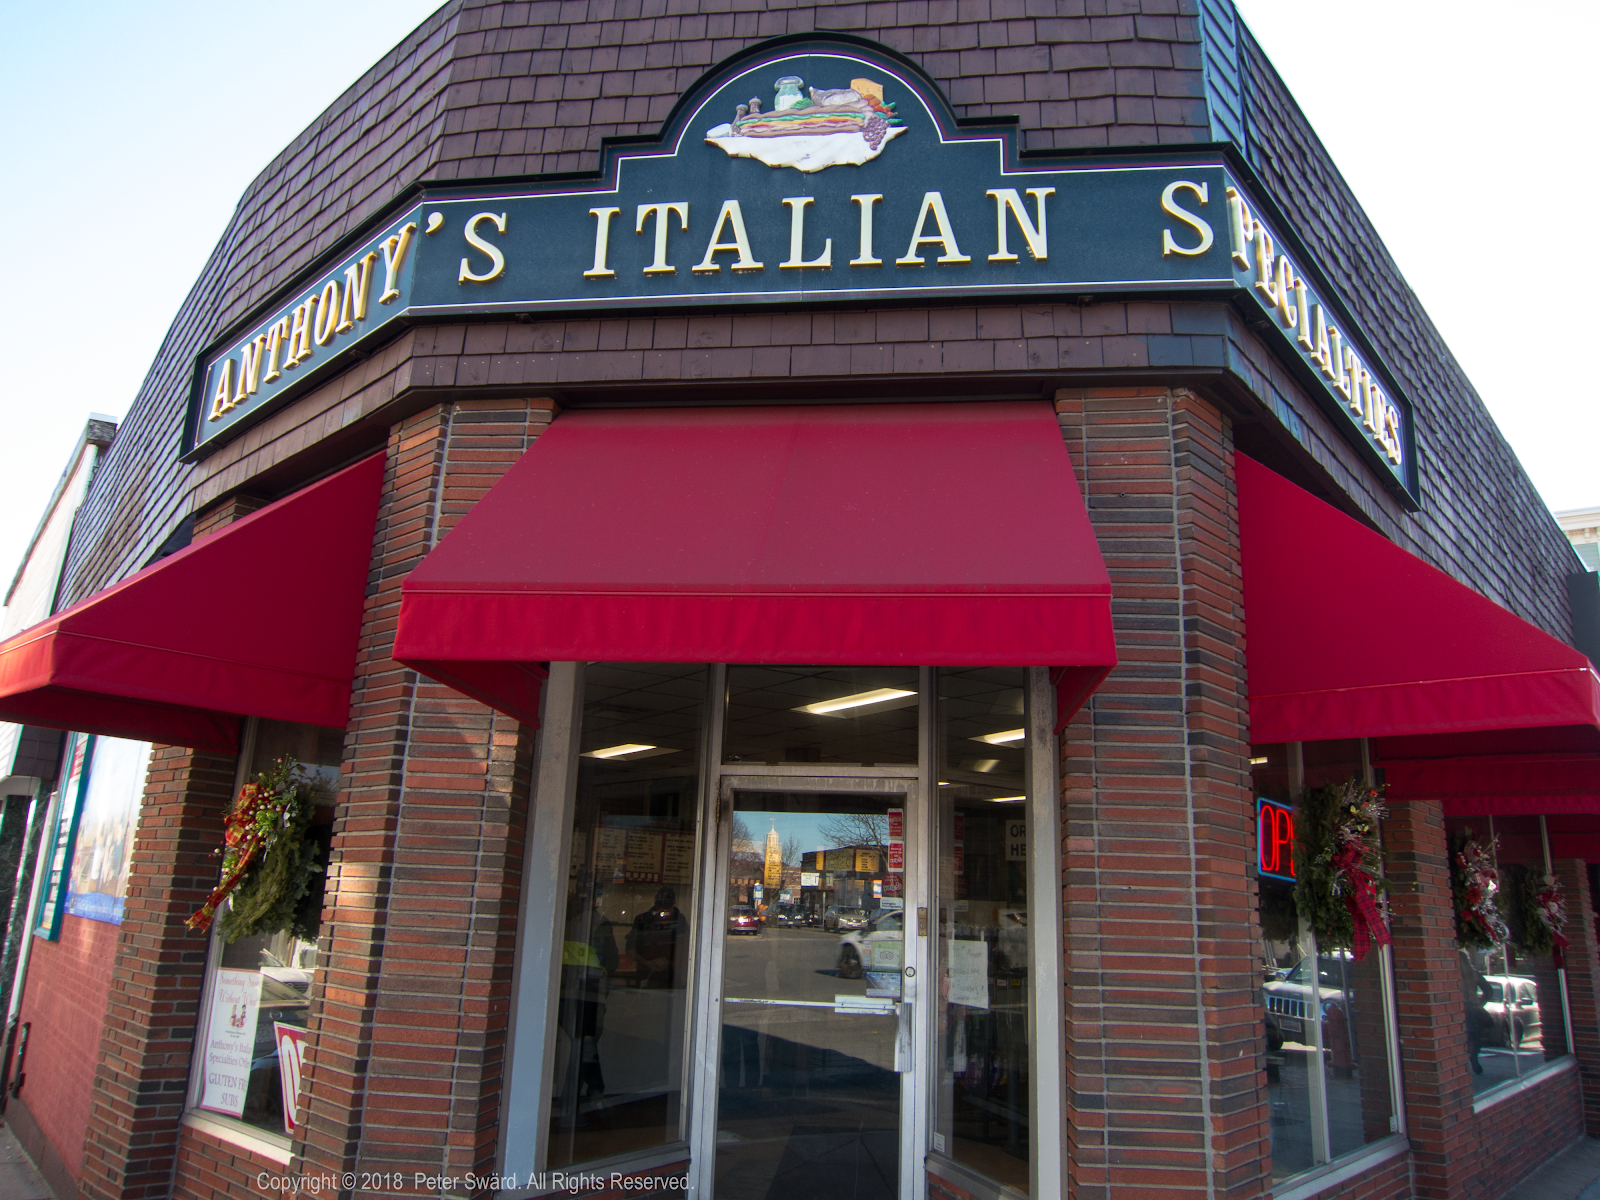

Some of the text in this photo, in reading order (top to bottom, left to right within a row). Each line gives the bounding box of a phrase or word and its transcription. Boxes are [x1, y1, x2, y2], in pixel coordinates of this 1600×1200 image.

[207, 179, 1402, 466] ANTHONY'S ITALIAN SPECIALTIES
[1260, 804, 1296, 876] OP
[1010, 843, 1026, 856] HE
[210, 1039, 239, 1054] Anthony's
[209, 1052, 238, 1066] Specialties
[208, 1072, 238, 1088] GLUTEN
[221, 1092, 239, 1108] SUBS
